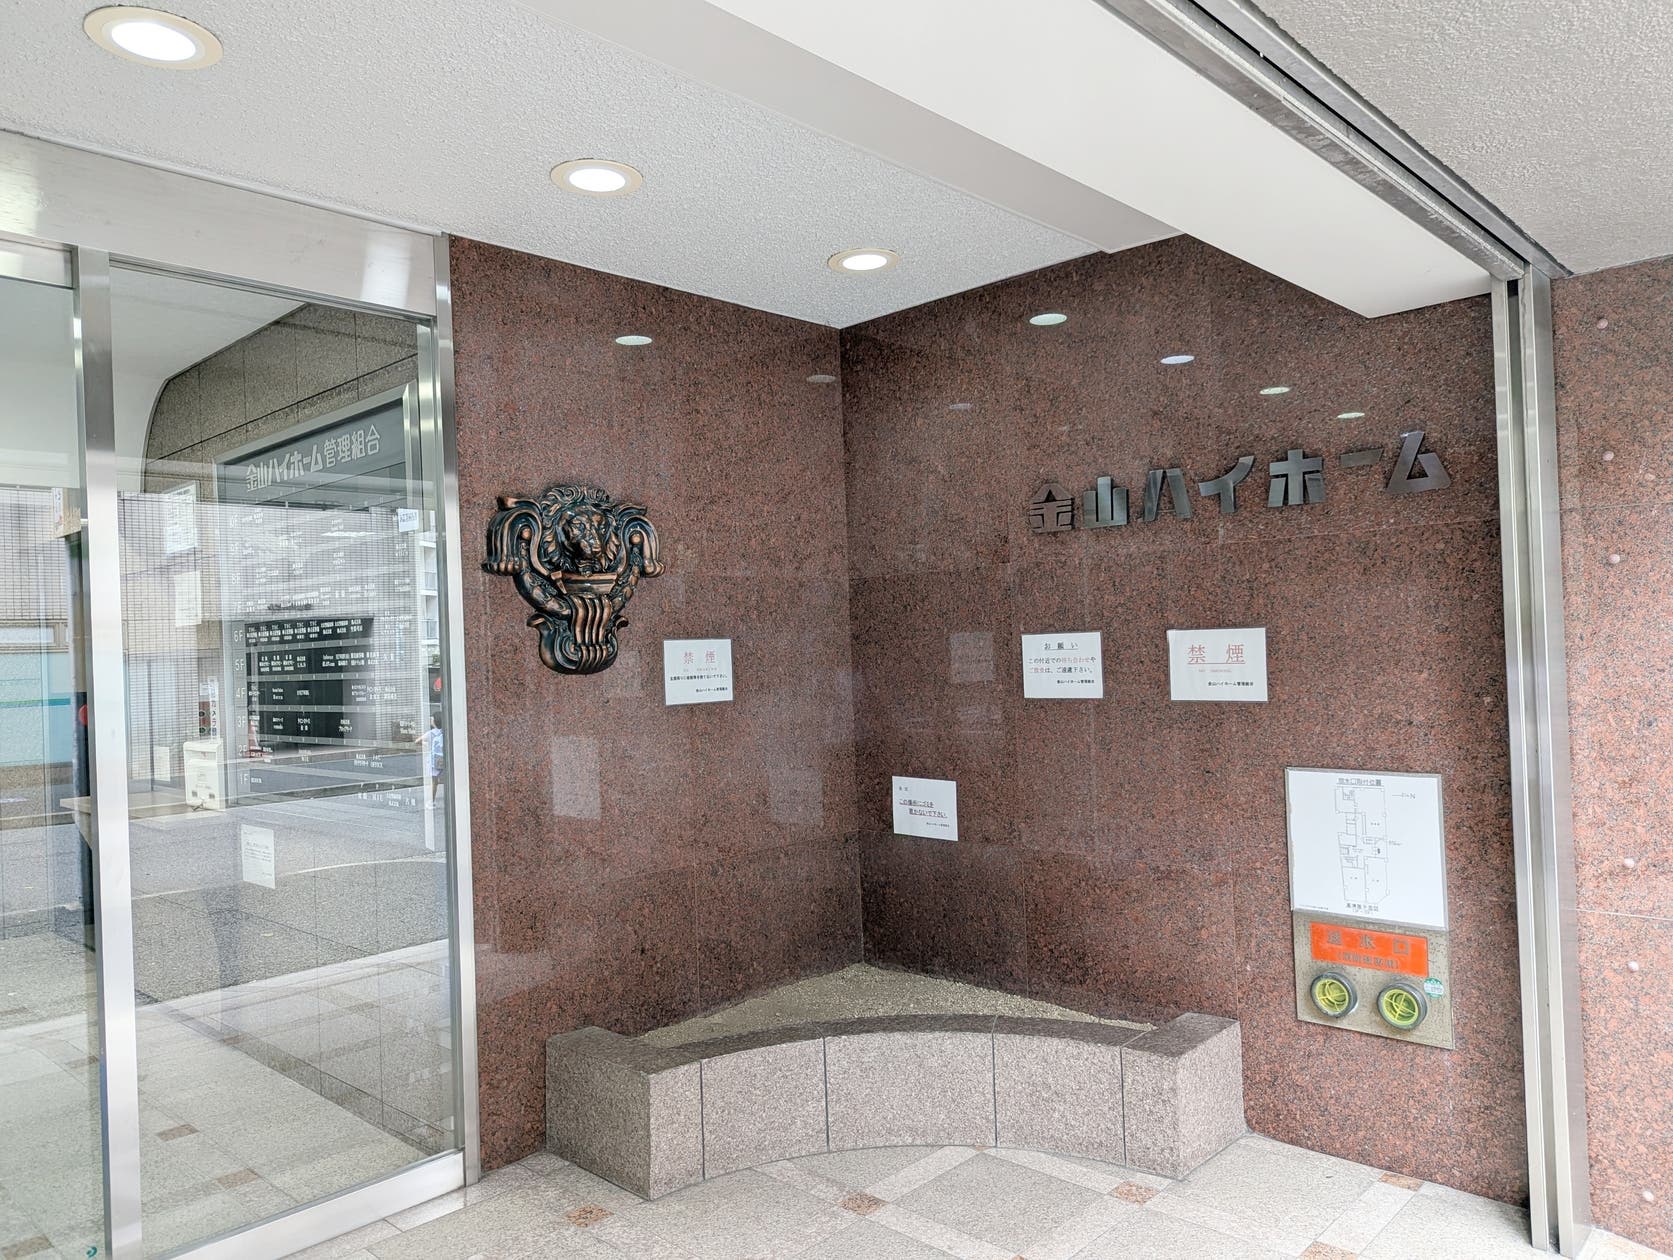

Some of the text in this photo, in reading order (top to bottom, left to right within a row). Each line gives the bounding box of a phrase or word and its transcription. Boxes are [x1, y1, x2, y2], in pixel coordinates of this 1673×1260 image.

[245, 423, 381, 492] 金山ハイホーム管理組合
[1029, 430, 1452, 534] 金山ハイホーム
[233, 630, 244, 642] 6F
[682, 648, 717, 665] 禁煙
[1187, 642, 1245, 663] 禁煙
